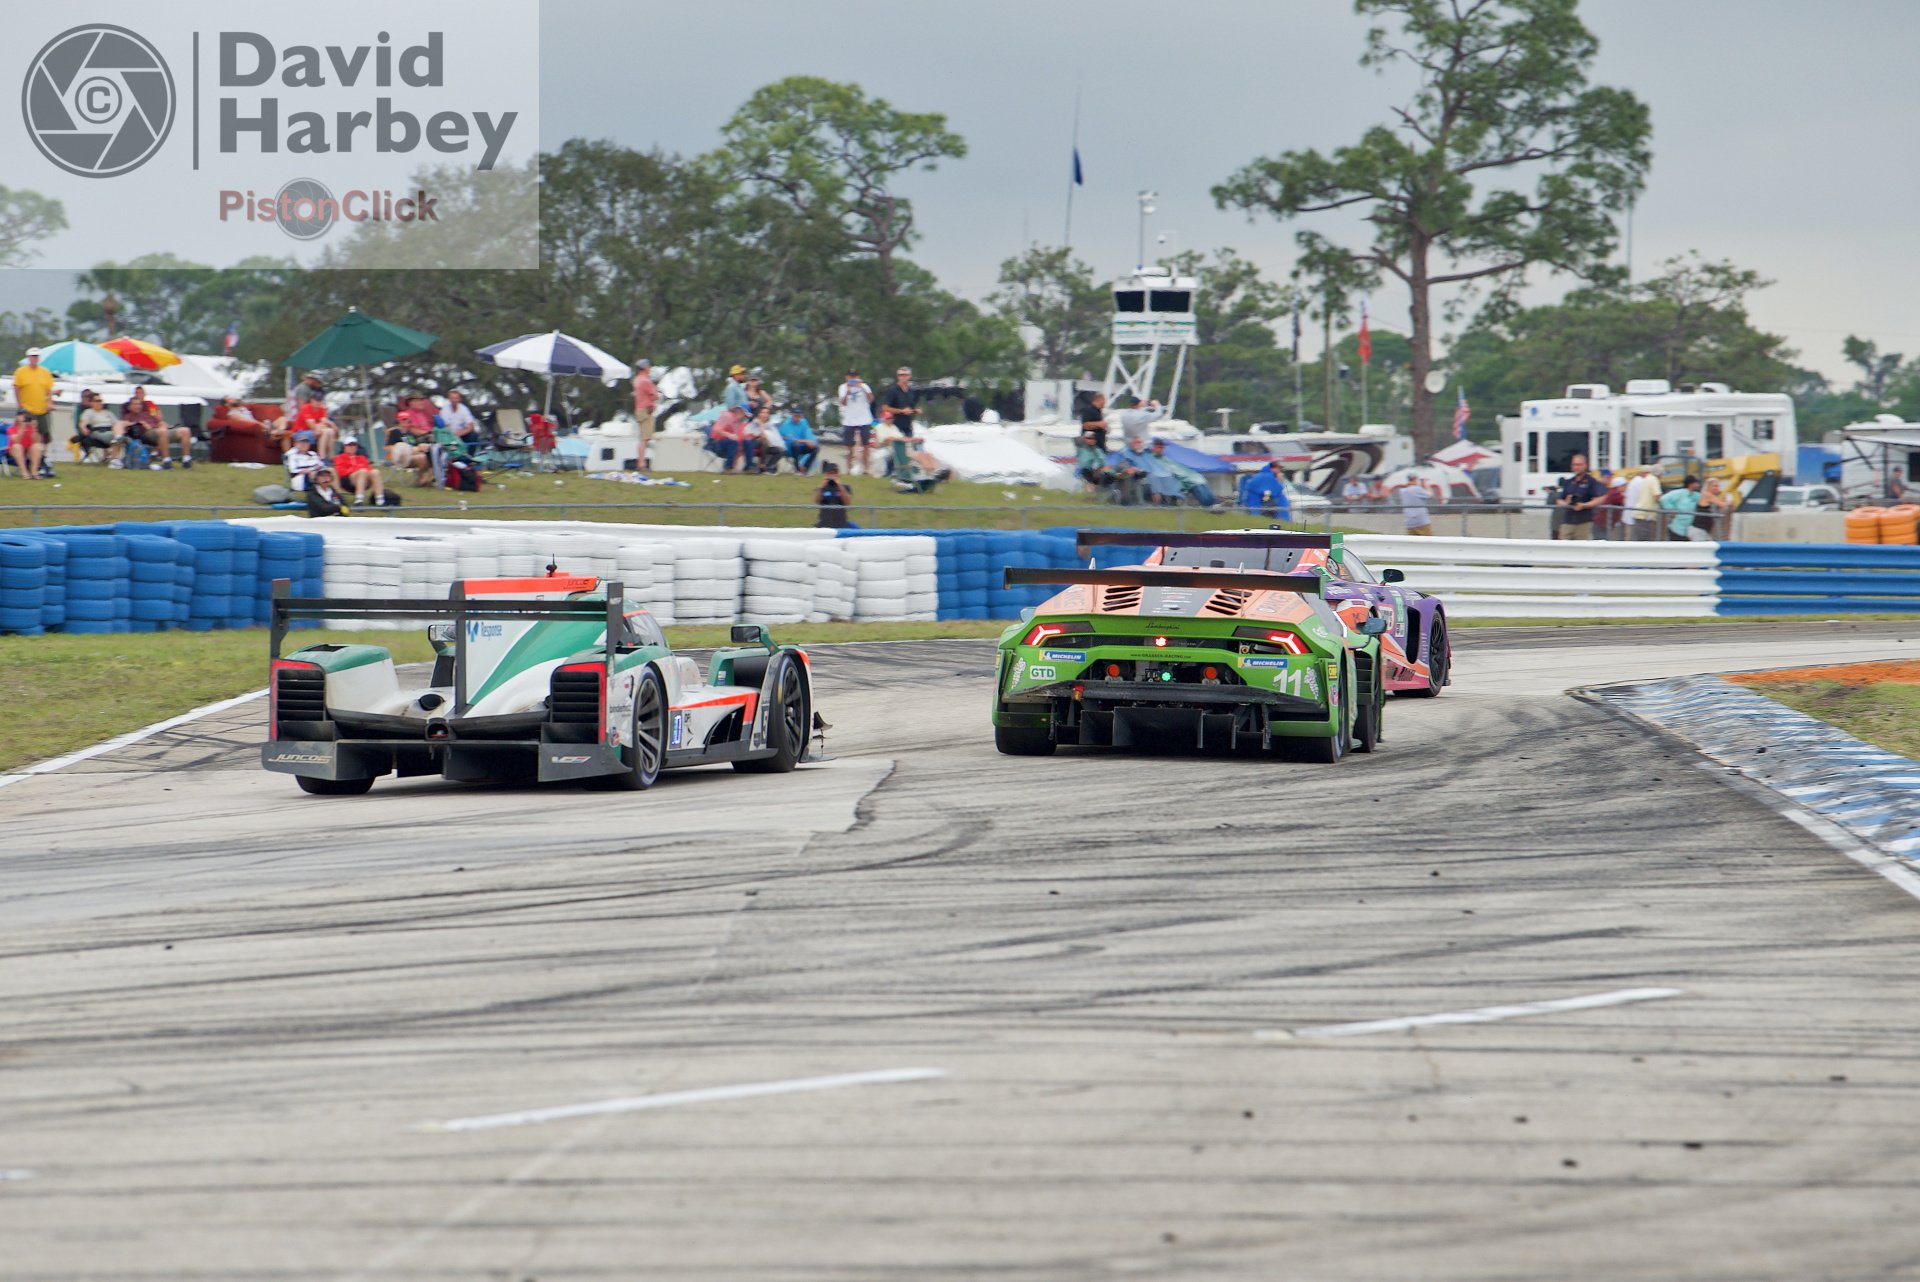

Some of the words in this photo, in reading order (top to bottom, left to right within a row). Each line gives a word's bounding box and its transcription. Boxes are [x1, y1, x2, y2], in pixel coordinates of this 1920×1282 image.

[481, 622, 502, 639] Response
[1031, 668, 1055, 678] GTD
[1274, 669, 1301, 697] 11
